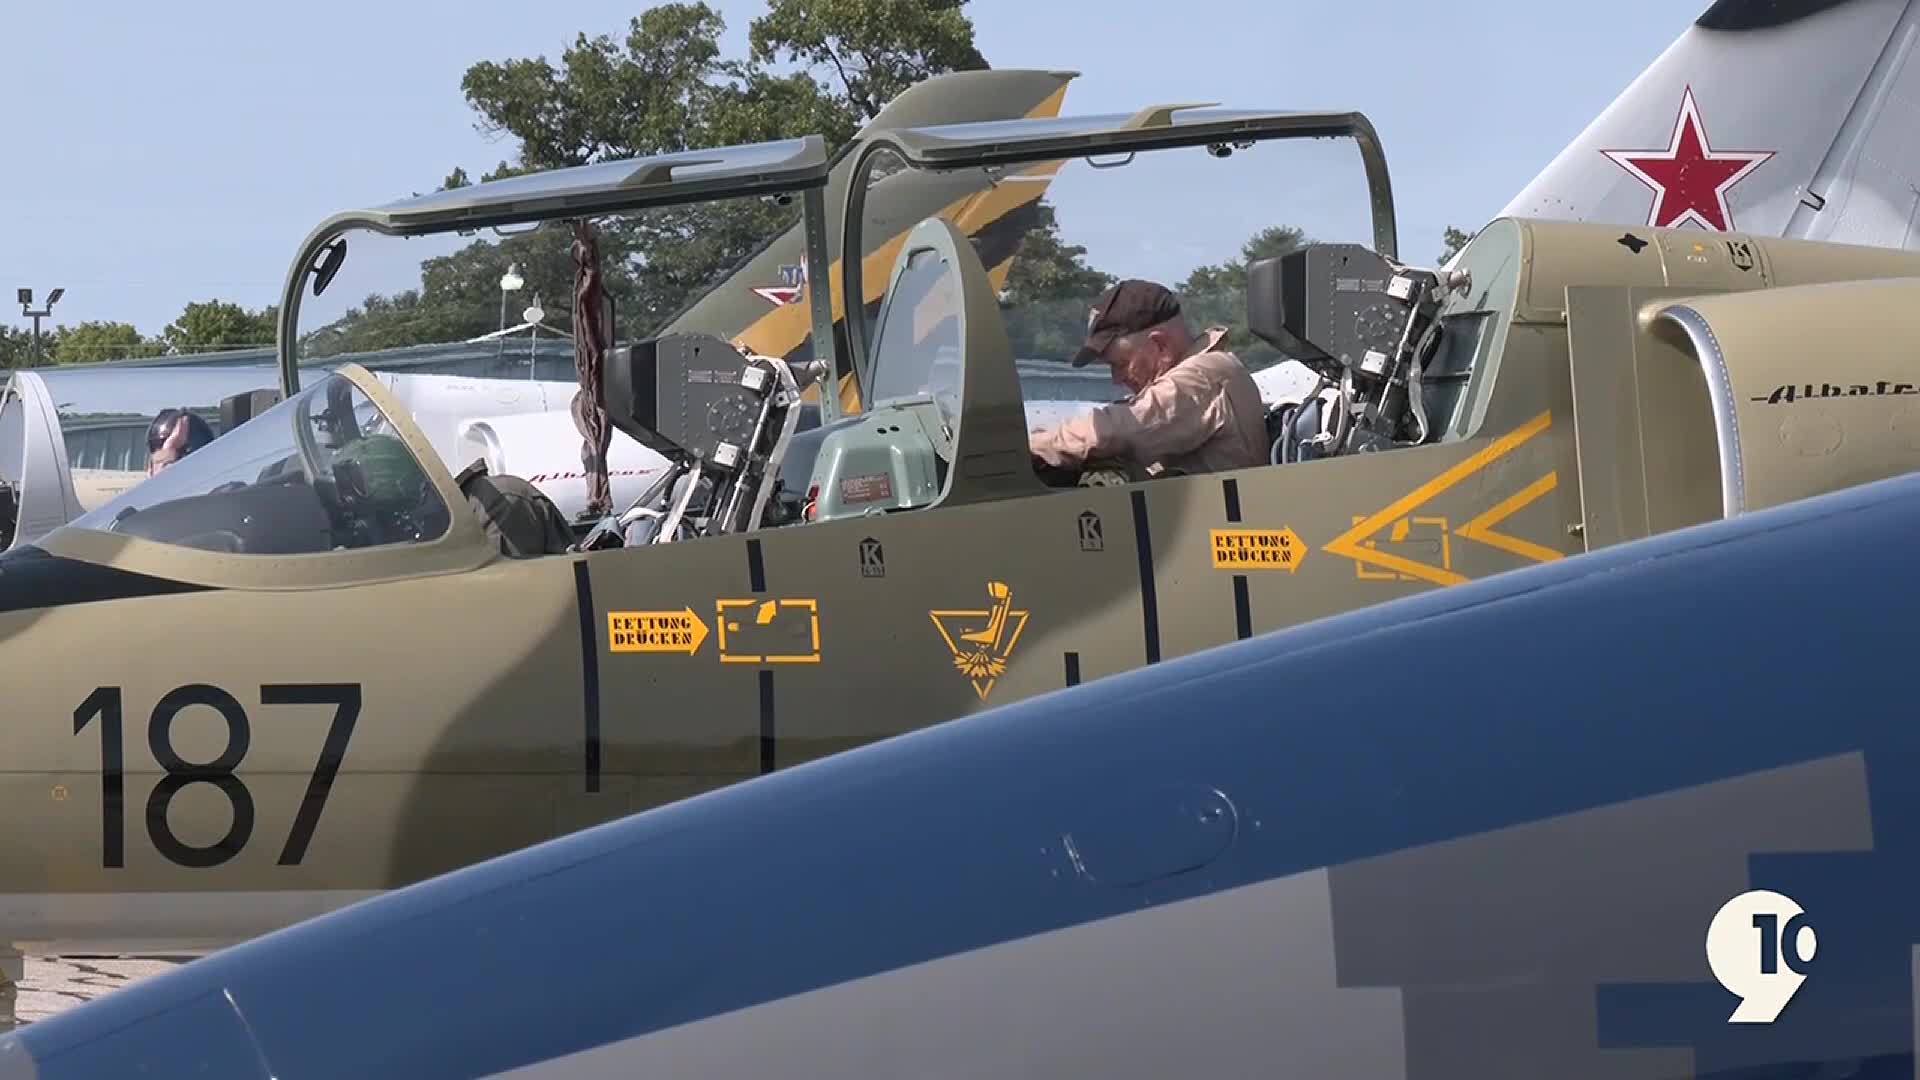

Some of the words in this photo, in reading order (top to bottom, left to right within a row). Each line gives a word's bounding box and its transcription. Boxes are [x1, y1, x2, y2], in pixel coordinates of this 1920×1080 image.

[1766, 382, 1920, 404] Albatr
[1081, 516, 1101, 540] K
[1215, 535, 1290, 547] RETTUNG
[863, 543, 883, 566] K
[1216, 548, 1292, 562] DRÜCKEN
[613, 617, 691, 630] RETTUNG
[614, 630, 692, 645] DRÜCKEN
[73, 683, 362, 868] 187
